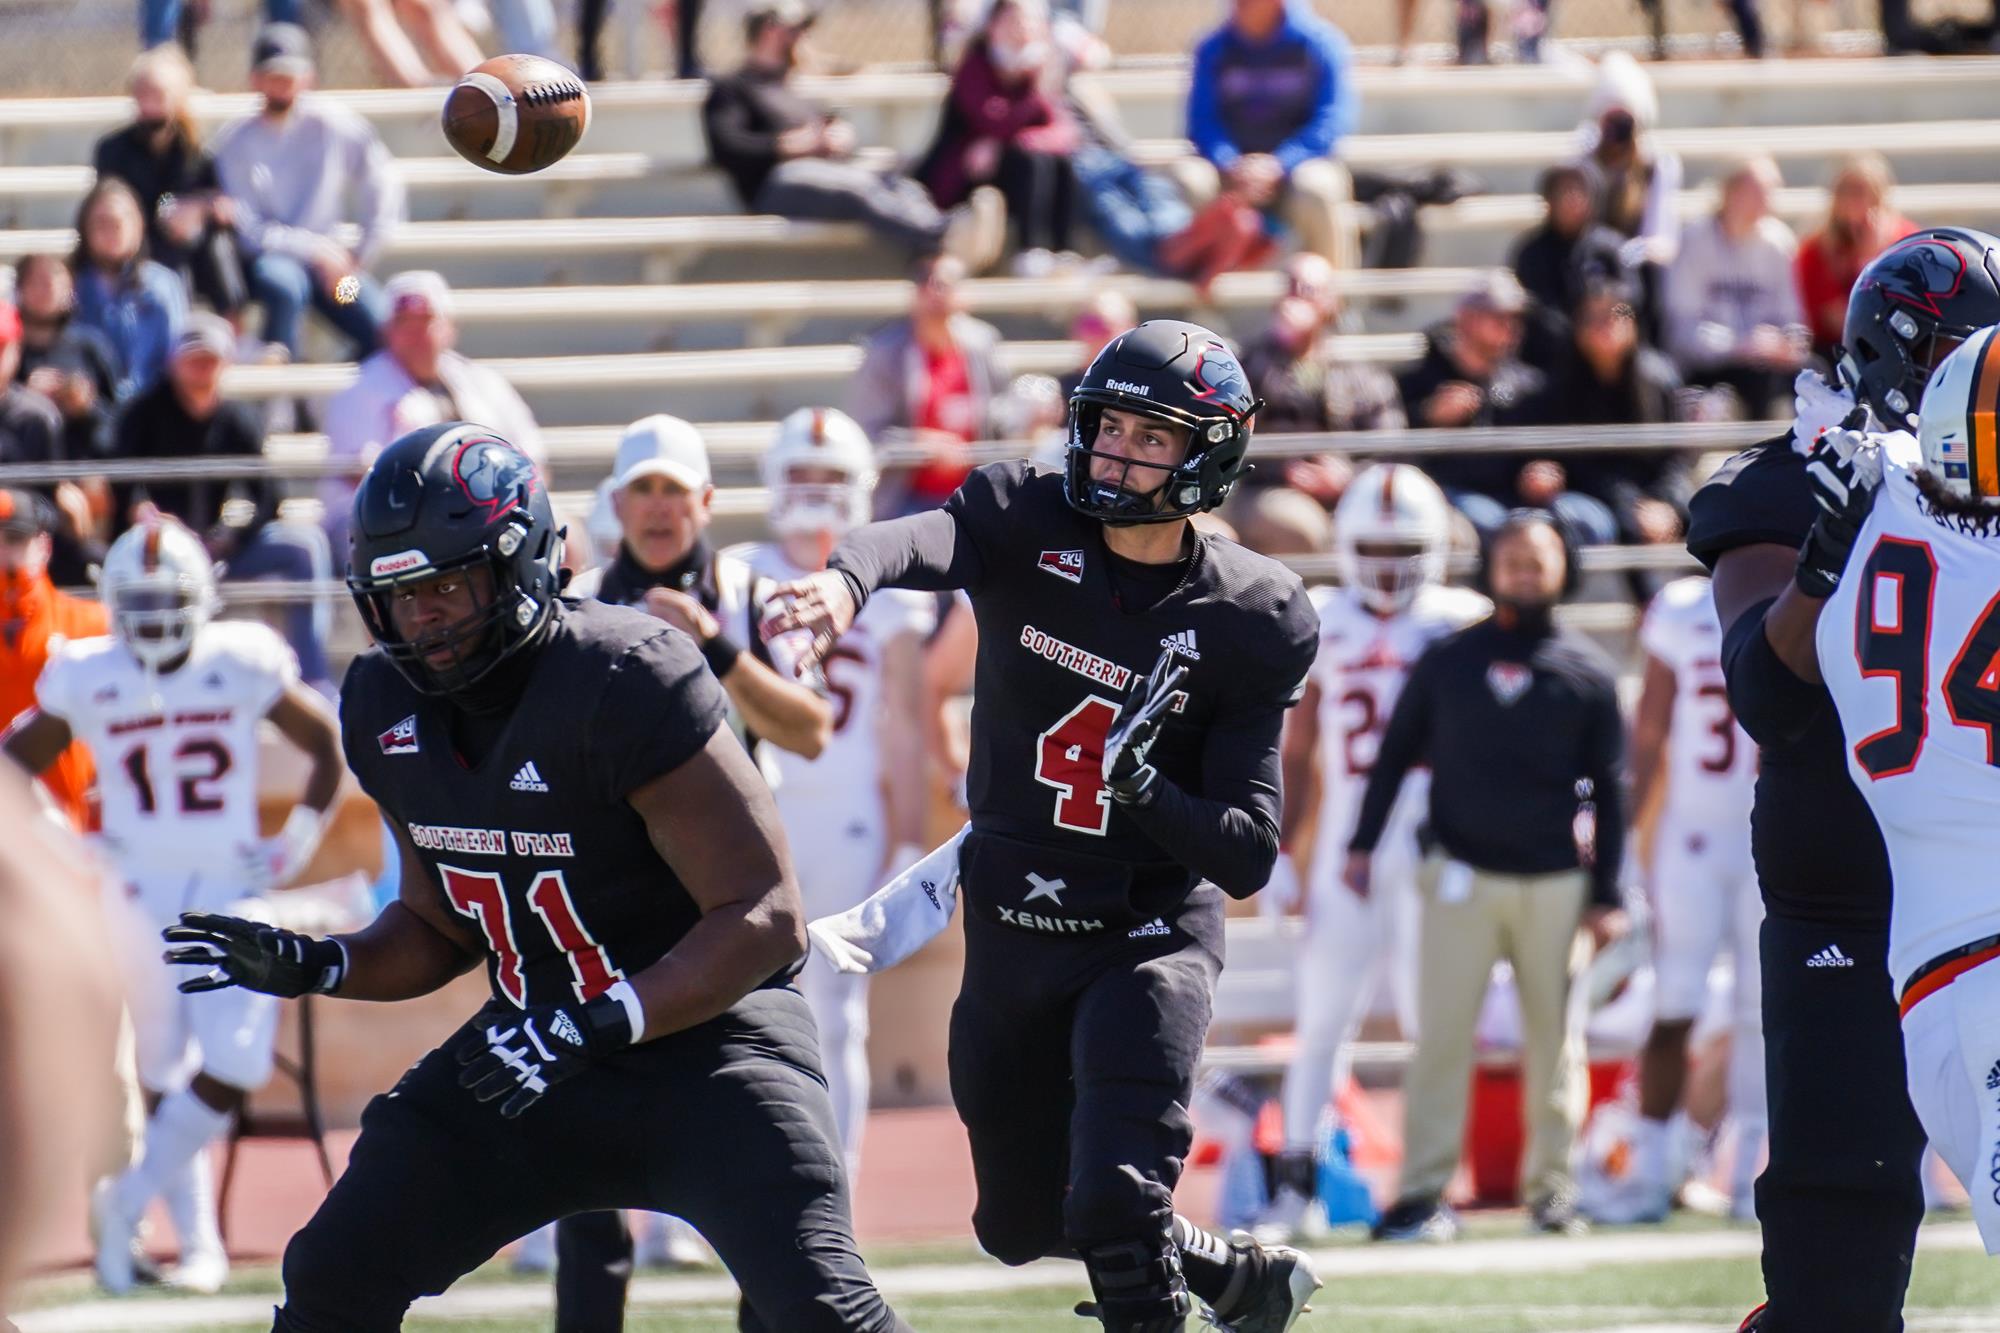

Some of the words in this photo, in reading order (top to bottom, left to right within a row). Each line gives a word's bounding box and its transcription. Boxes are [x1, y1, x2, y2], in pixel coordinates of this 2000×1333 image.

[1105, 378, 1150, 397] Riddell
[1058, 552, 1082, 568] SKY
[1020, 624, 1132, 691] SOUTHERN
[1160, 638, 1201, 661] adidas
[120, 737, 235, 816] 12
[1034, 694, 1123, 836] 4
[509, 779, 549, 793] adidas
[408, 821, 507, 856] SOUTHERN
[511, 831, 575, 857] UTAH
[996, 904, 1105, 933] XENITH
[1127, 924, 1171, 938] adidas
[436, 862, 626, 1010] 71
[1806, 957, 1855, 968] adidas
